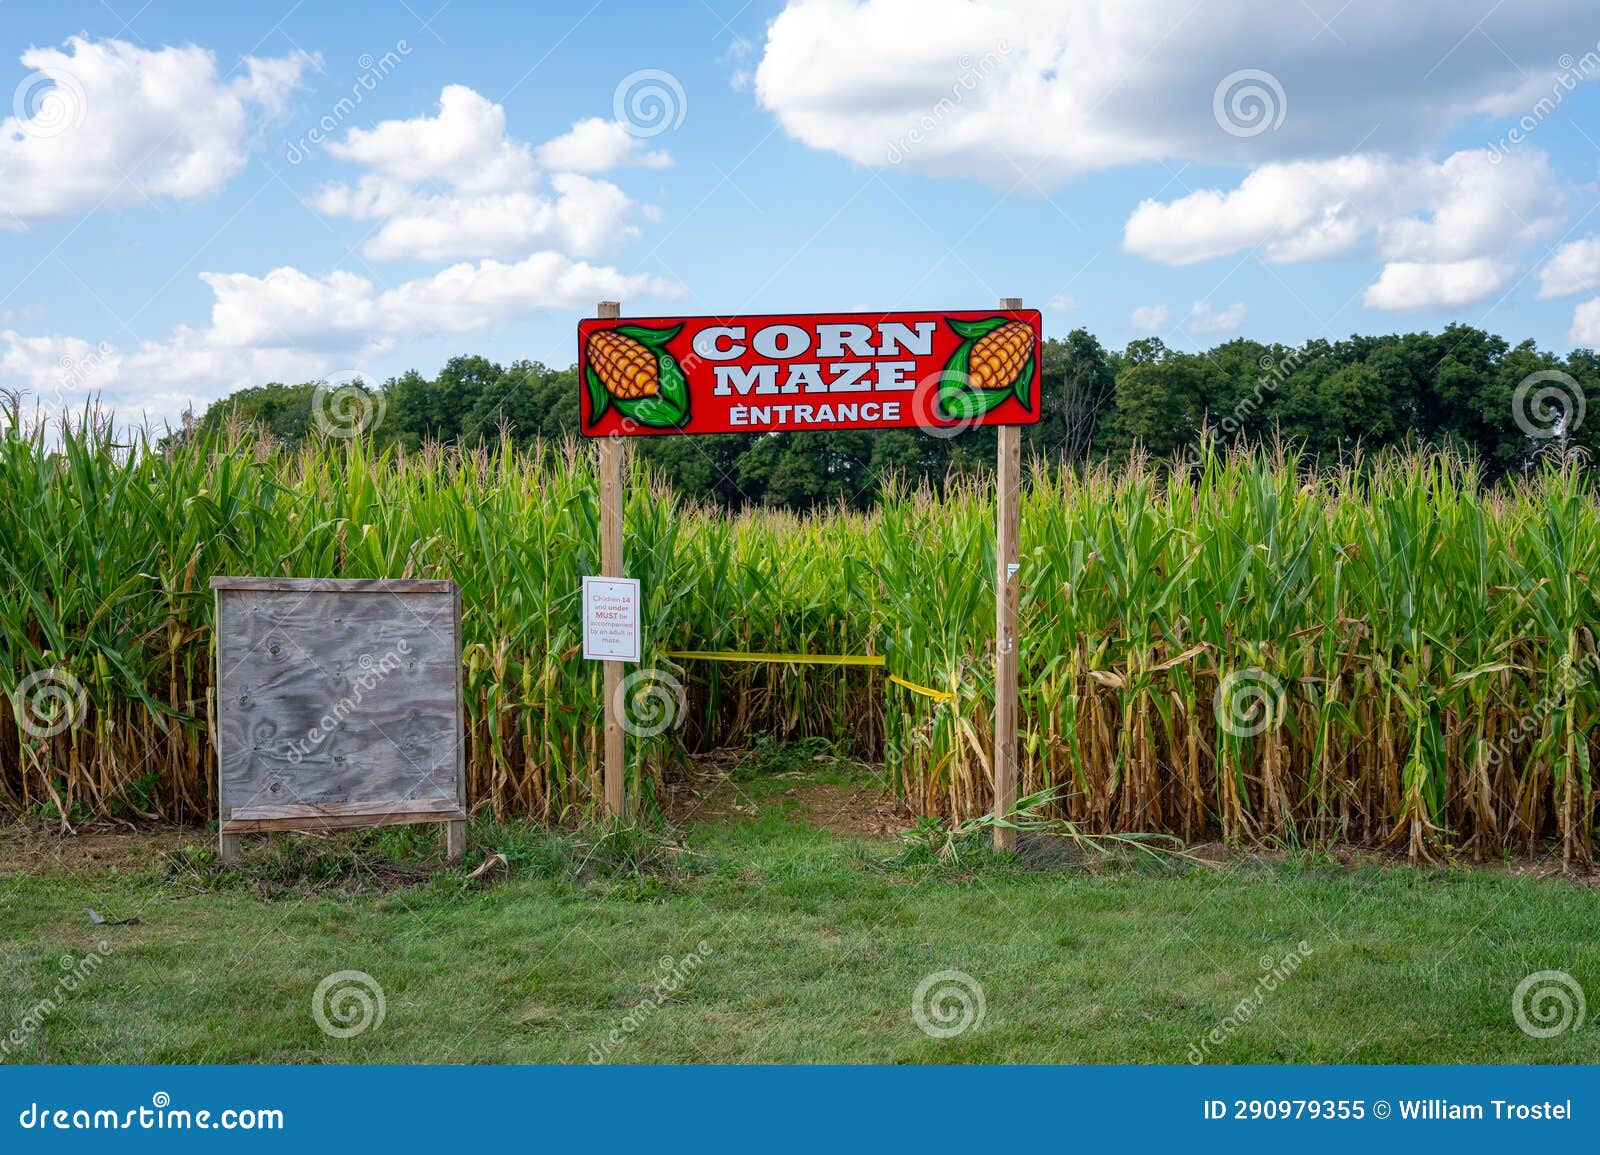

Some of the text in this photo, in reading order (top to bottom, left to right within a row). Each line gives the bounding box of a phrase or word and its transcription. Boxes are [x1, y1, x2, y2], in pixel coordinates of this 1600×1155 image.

[691, 321, 937, 361] CORN
[713, 360, 917, 397] MAZE
[728, 401, 901, 426] ENTRANCE
